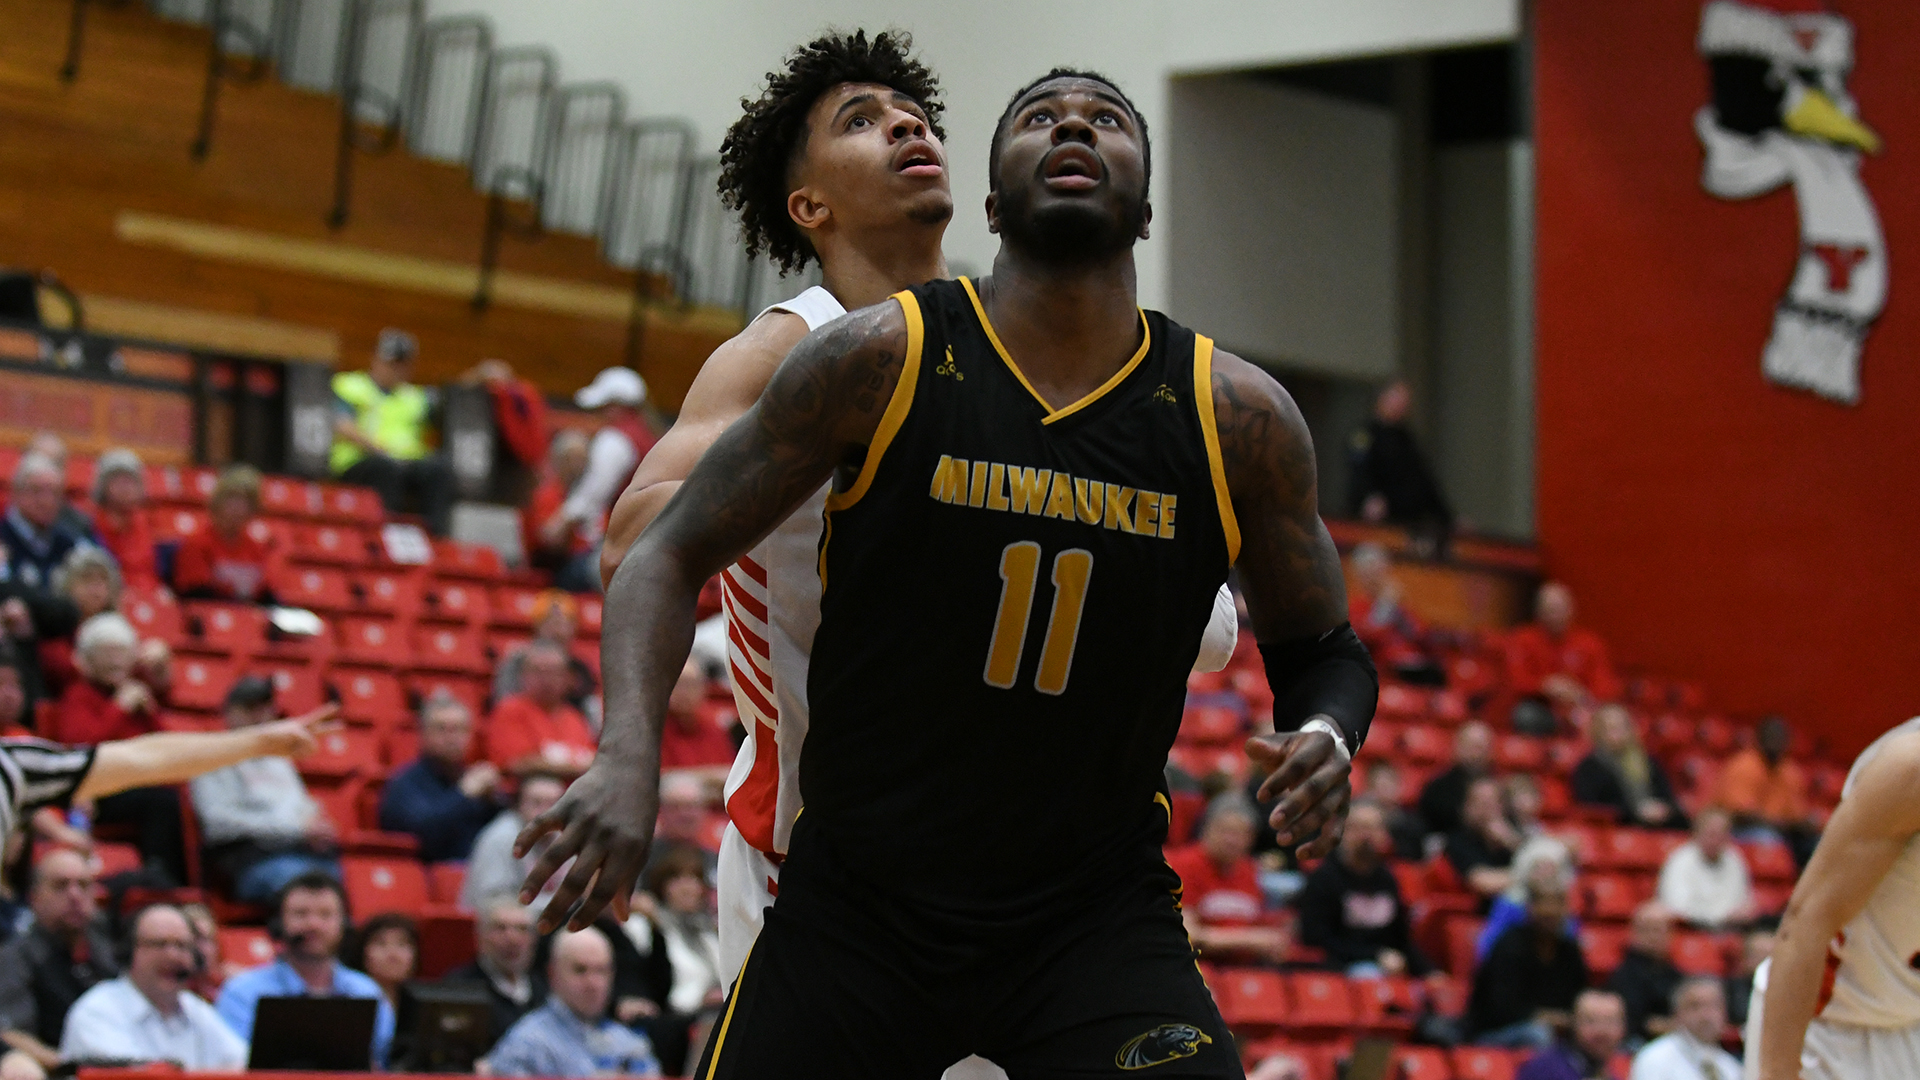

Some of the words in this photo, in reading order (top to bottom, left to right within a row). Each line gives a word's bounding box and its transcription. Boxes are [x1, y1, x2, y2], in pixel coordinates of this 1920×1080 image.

[1814, 244, 1868, 293] Y
[930, 455, 1177, 540] MILWAUKEE
[983, 540, 1094, 696] 11
